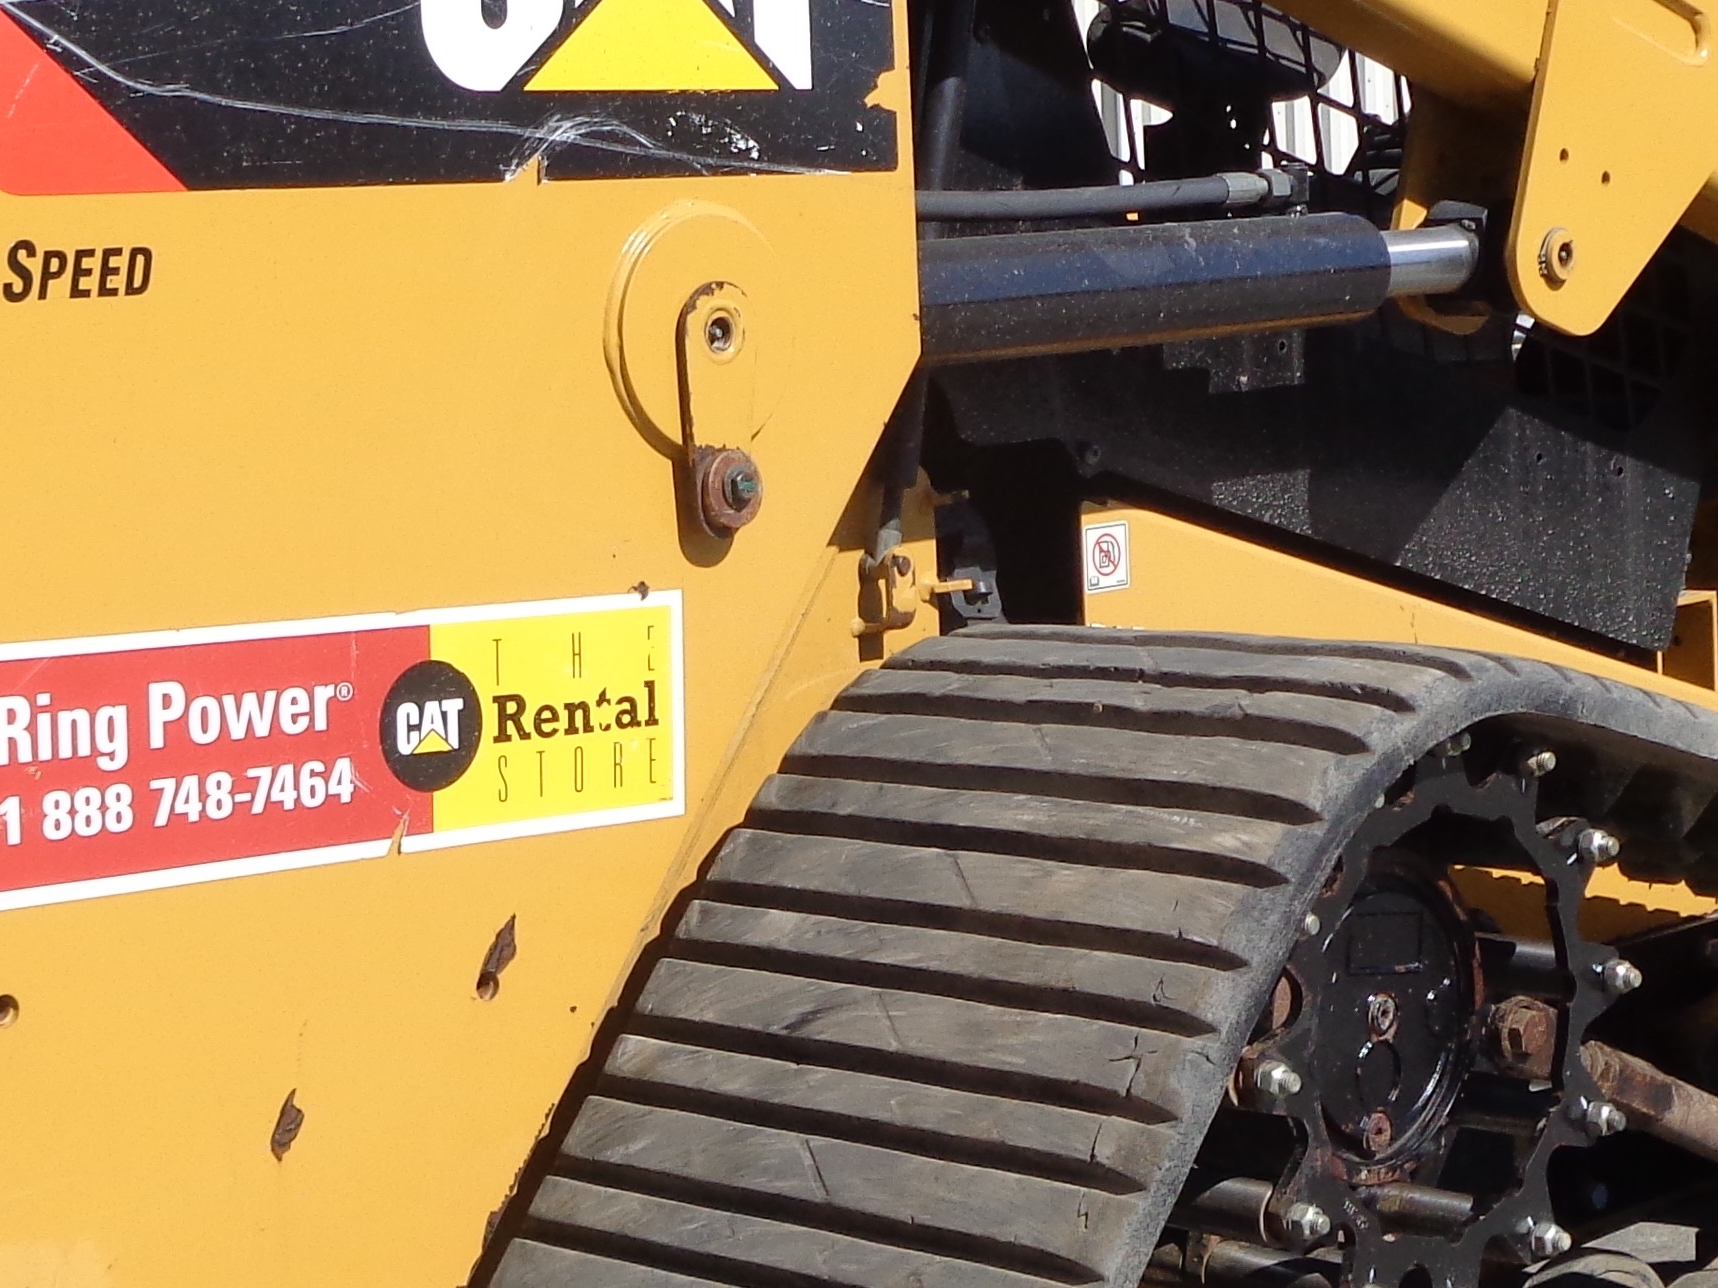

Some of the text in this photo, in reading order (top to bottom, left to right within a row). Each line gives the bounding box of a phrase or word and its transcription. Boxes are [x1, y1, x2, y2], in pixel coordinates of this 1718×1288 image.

[492, 625, 655, 686] THE
[396, 697, 464, 756] CAT
[492, 679, 660, 744] Rental
[41, 783, 134, 841] 888
[149, 756, 355, 828] 748-7464
[497, 738, 657, 803] STORE
